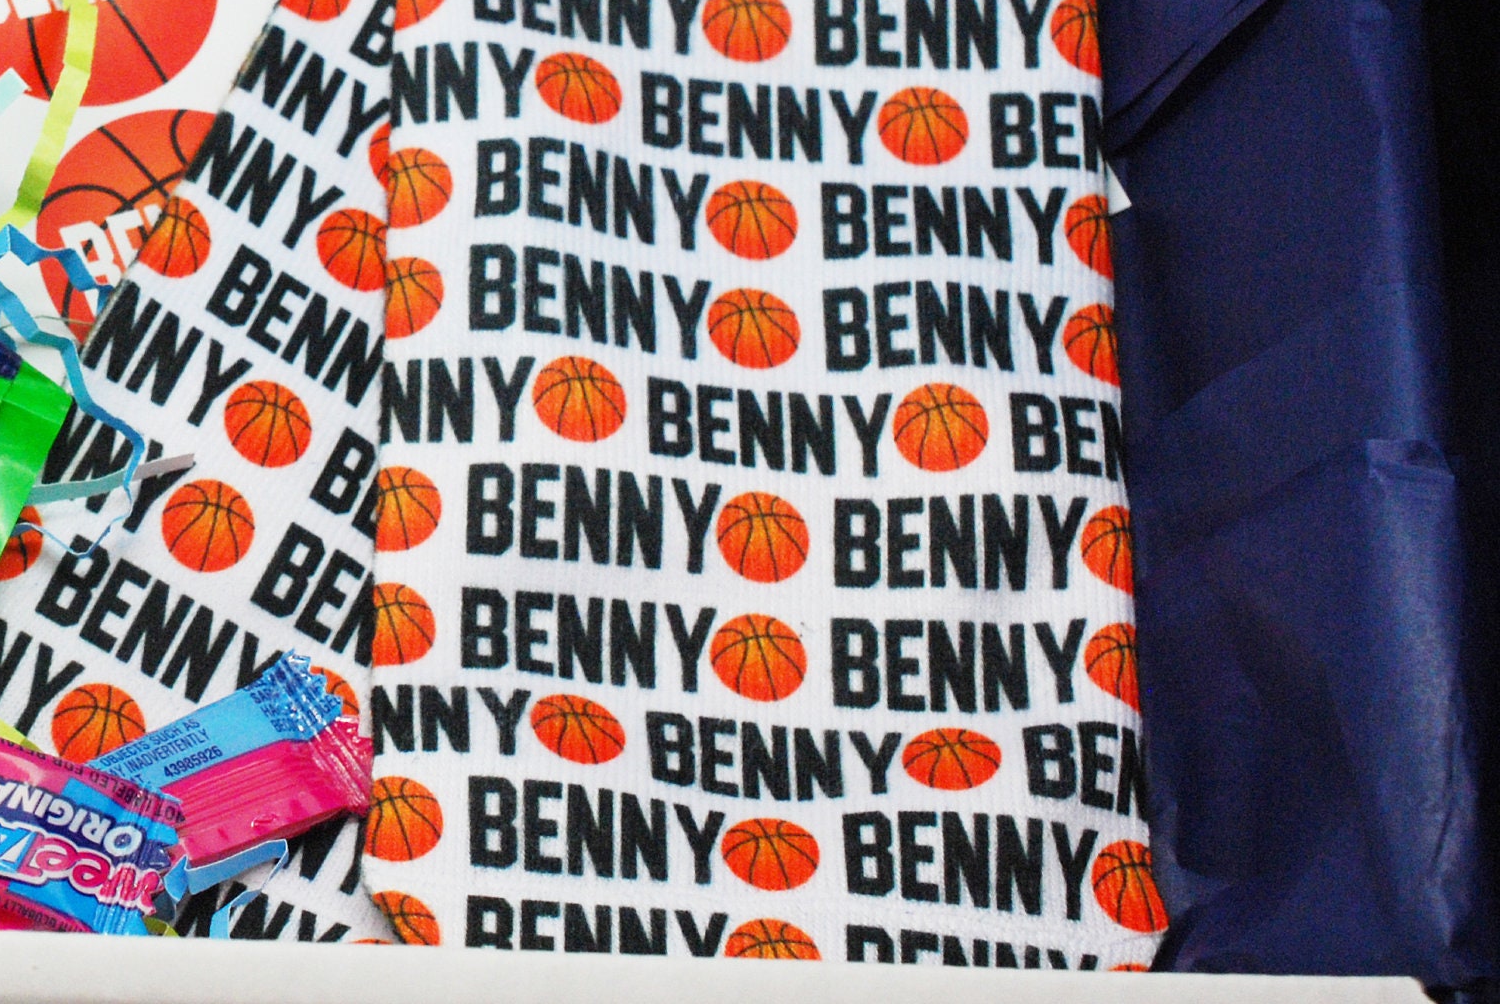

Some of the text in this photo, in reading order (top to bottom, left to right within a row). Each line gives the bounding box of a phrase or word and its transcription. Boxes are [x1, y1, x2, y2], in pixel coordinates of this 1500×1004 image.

[237, 24, 390, 159] NNY
[391, 40, 535, 127] NNY
[640, 71, 877, 166] BENNY
[183, 113, 344, 251] NNY
[475, 136, 1067, 266] BENNY BENNY
[81, 279, 254, 427] NNY
[205, 244, 386, 410] BENN
[469, 243, 1068, 376] BENNY BENNY
[379, 356, 535, 444] NNY
[647, 376, 893, 477] BENNY
[465, 462, 721, 574] BENNY
[833, 494, 1088, 591] BENNY
[35, 534, 283, 703] BENNY
[461, 586, 1088, 714] BENNY BENNY
[102, 718, 201, 769] OBJECTS SUCH AS
[123, 727, 211, 774] INADVERTENTLY
[162, 746, 224, 779] 43985926
[372, 685, 531, 757] NNY
[645, 711, 902, 801] BENNY
[467, 775, 725, 885] BENNY
[843, 809, 1098, 921] BENNY
